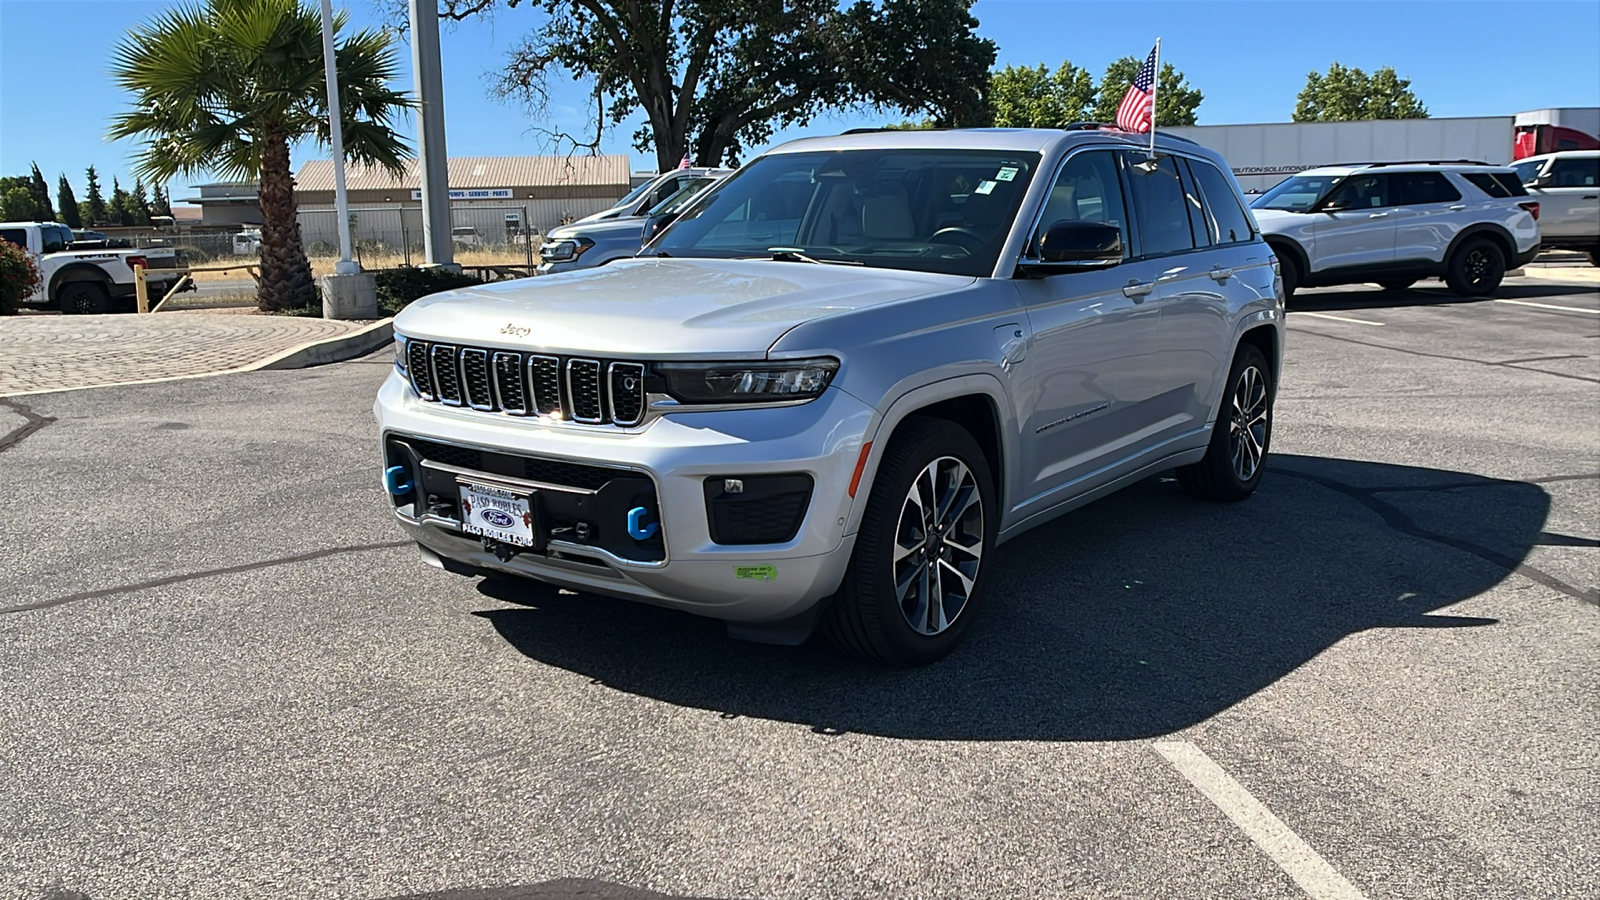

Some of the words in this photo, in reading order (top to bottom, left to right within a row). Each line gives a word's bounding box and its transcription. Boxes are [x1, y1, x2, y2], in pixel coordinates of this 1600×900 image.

[1264, 165, 1307, 173] SOLUTIONS
[500, 323, 531, 338] Jeep
[470, 494, 490, 509] PASO
[492, 498, 523, 518] ROBLES
[488, 512, 508, 525] Ford
[462, 523, 482, 536] PASO
[483, 528, 511, 542] ROBLES
[512, 534, 534, 547] FORD
